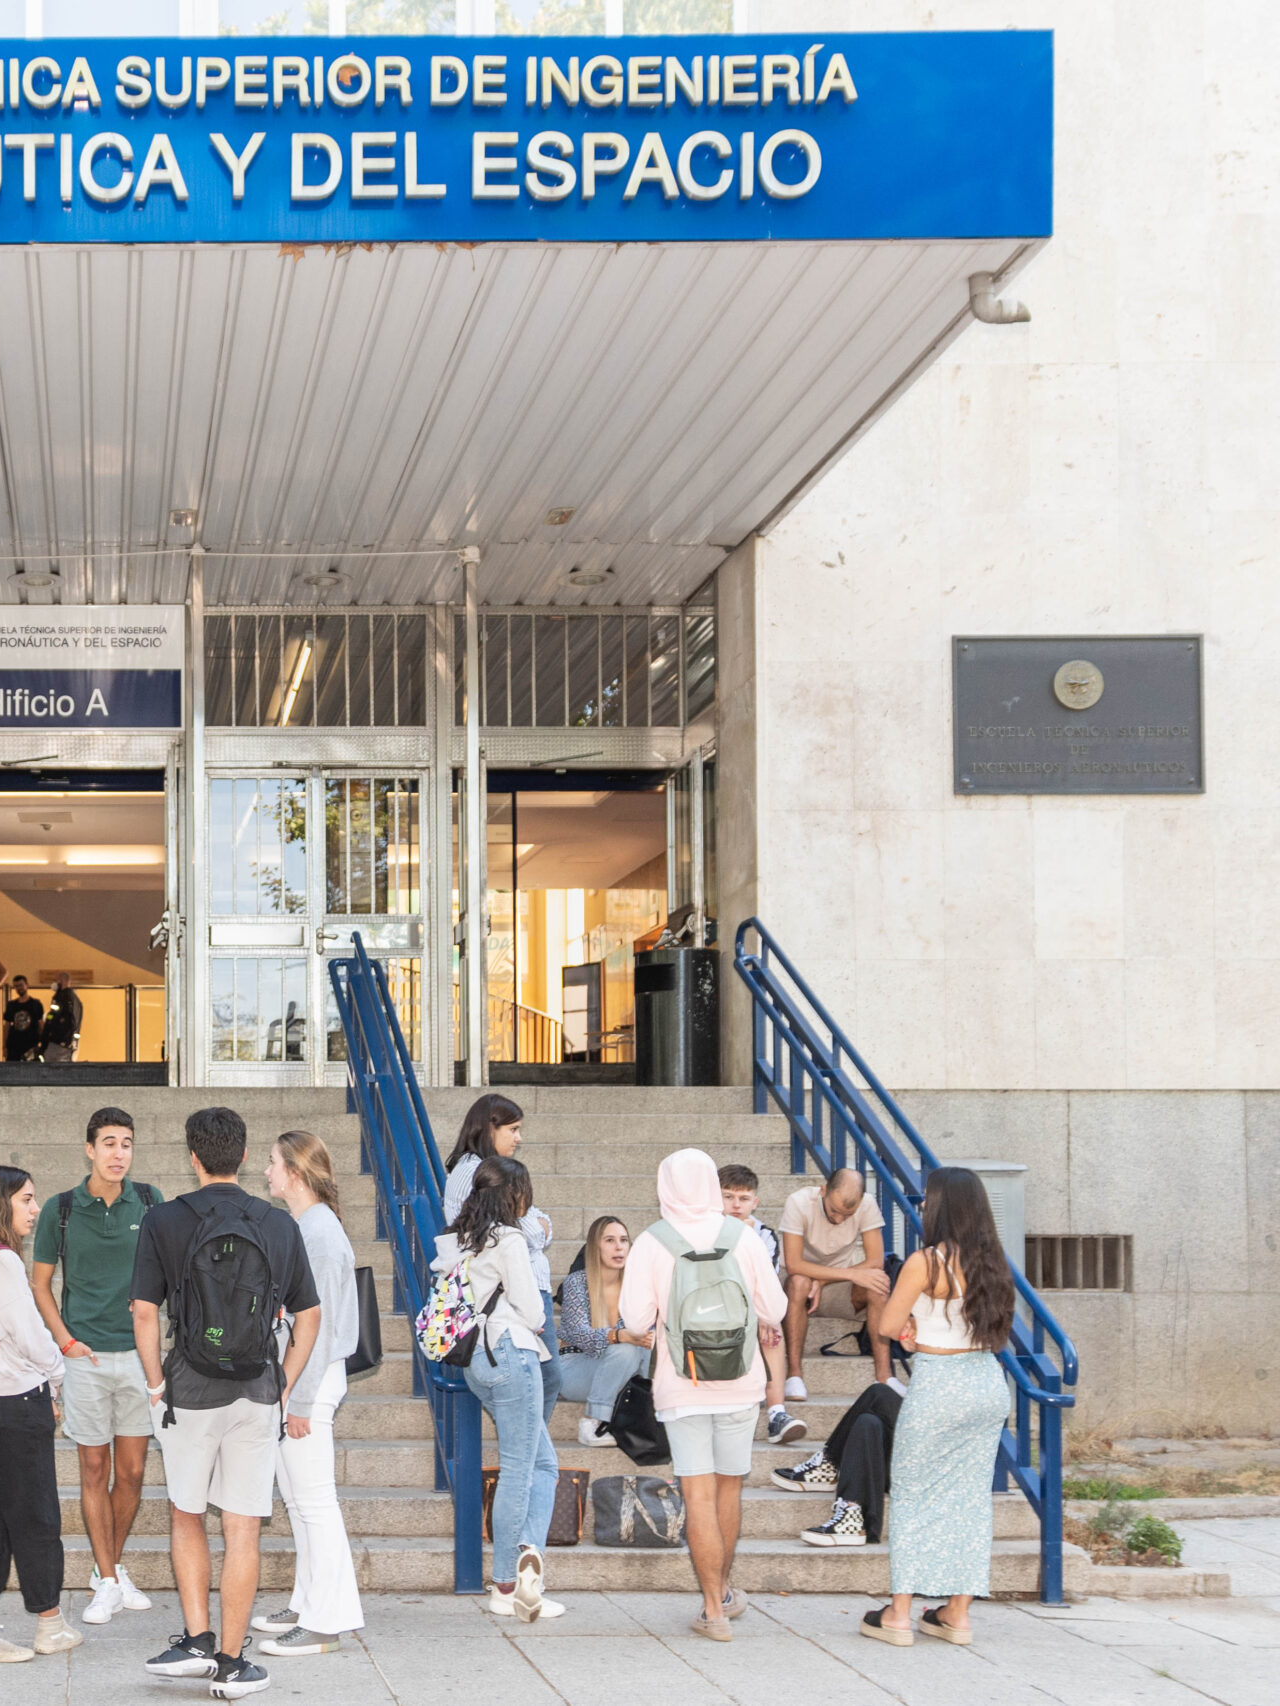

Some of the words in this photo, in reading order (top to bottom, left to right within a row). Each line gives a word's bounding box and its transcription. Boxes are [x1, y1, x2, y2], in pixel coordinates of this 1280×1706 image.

[116, 54, 414, 110] SUPERIOR
[430, 55, 508, 107] DE
[525, 44, 859, 108] INGENIERÍA
[208, 131, 267, 200] Y
[290, 131, 447, 200] DEL
[472, 128, 823, 203] ESPACIO
[20, 625, 57, 634] TÉCNICA
[58, 626, 102, 634] SUPERIOR
[104, 626, 117, 634] DE
[118, 625, 168, 635] INGENIERÍA
[72, 637, 81, 648] Y
[84, 637, 108, 648] DEL
[110, 637, 162, 648] ESPACIO
[85, 687, 109, 717] A
[968, 726, 1036, 737] ESCUELA
